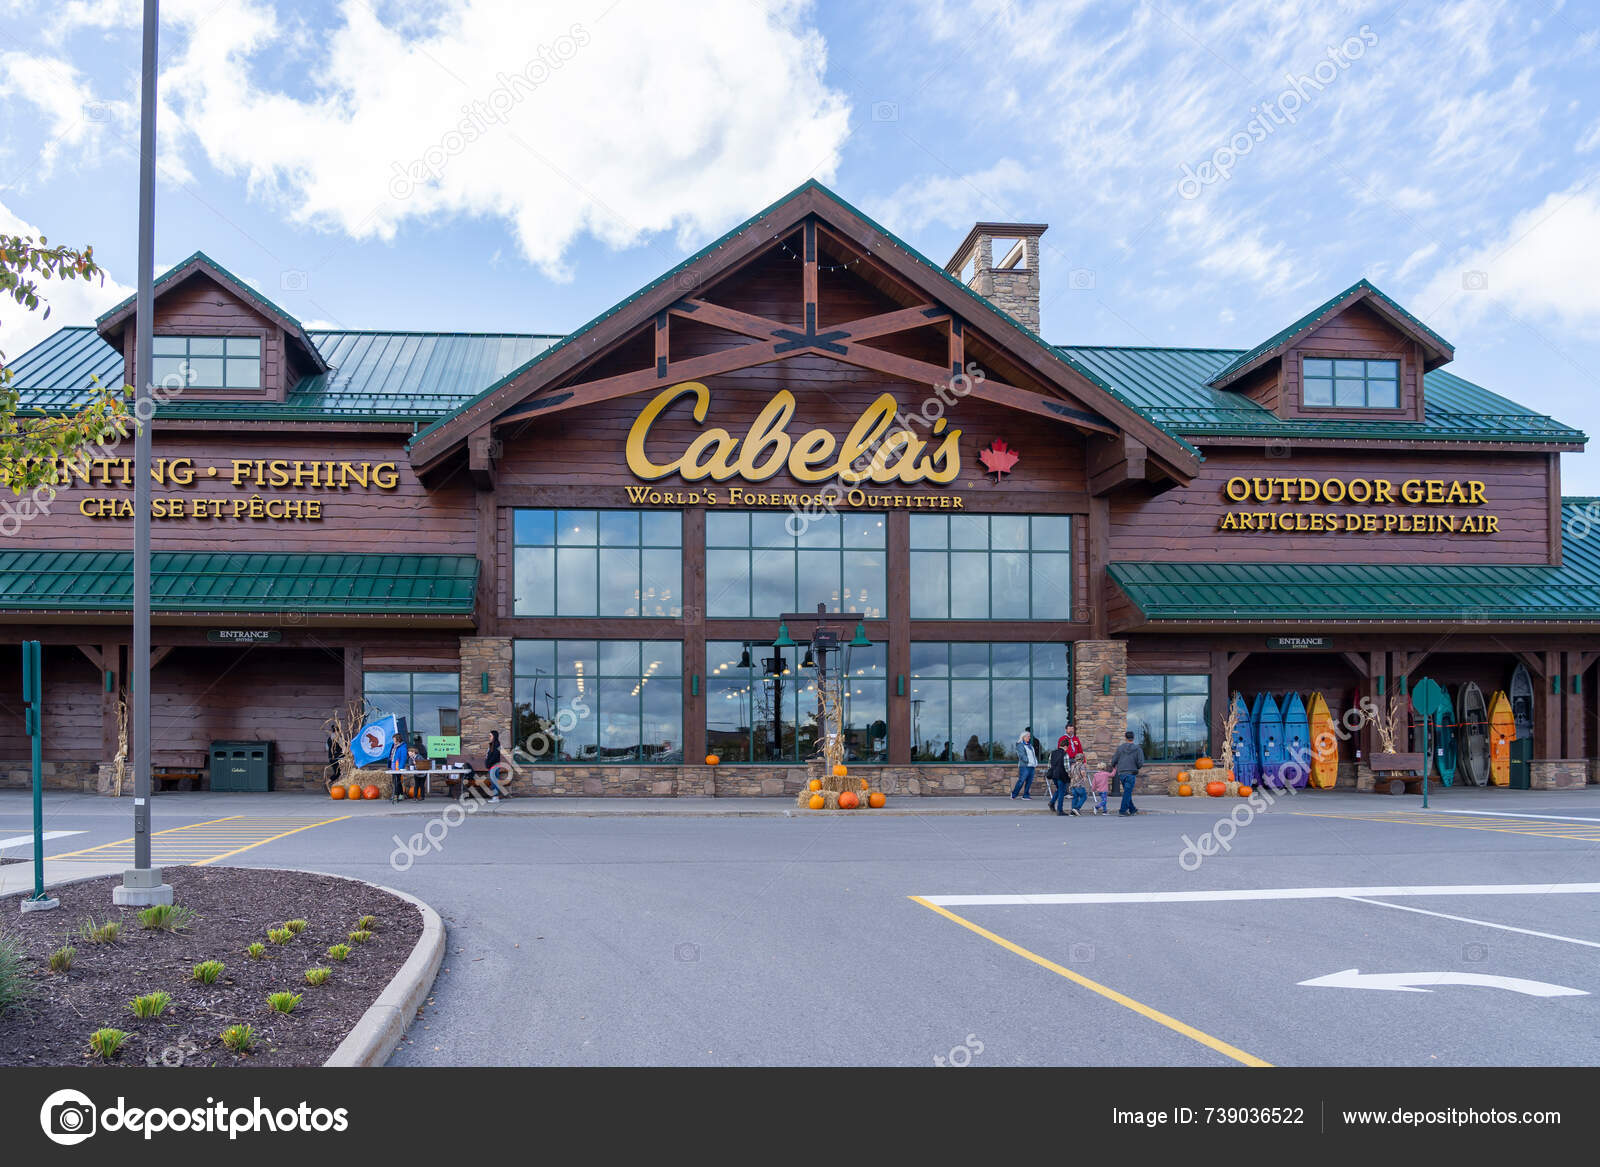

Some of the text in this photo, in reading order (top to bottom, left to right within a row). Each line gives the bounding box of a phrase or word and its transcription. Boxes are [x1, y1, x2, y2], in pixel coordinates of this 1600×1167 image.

[625, 381, 963, 484] Cabela's
[231, 460, 399, 489] FISHING
[1226, 476, 1489, 504] OUTDOOR GEAR
[79, 494, 322, 519] CHASE ET PÊCHE
[1222, 511, 1500, 534] ARTICLES DE PLEIN AIR
